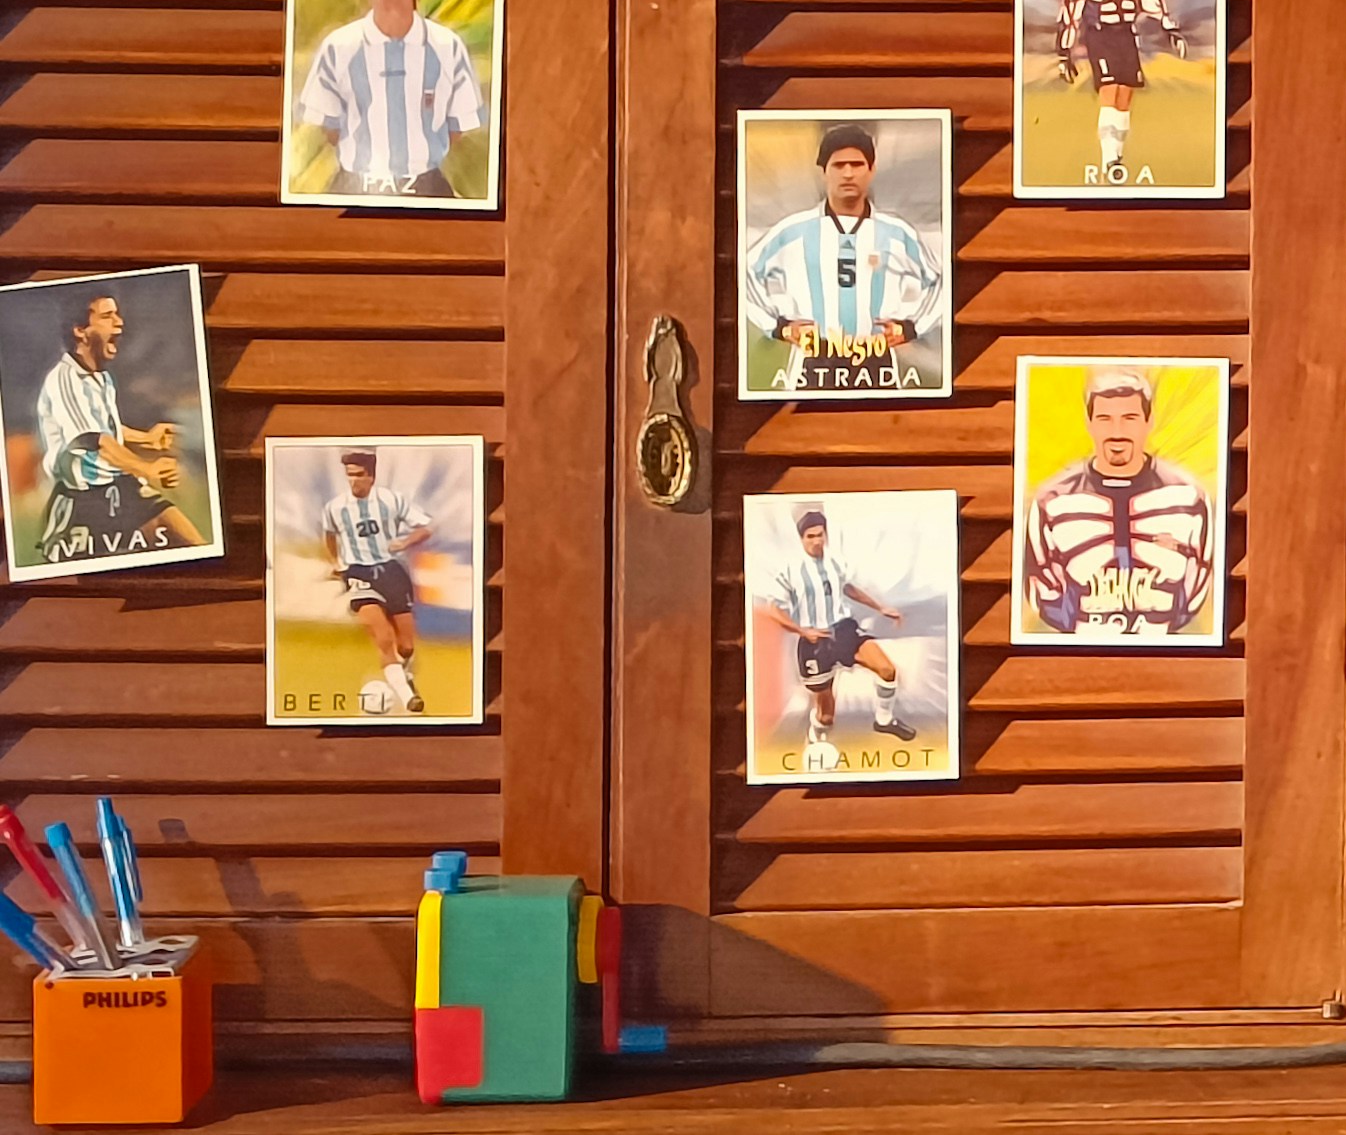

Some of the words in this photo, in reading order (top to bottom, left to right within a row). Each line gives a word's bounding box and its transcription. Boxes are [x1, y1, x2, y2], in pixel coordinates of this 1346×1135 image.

[361, 173, 418, 194] PAZ
[1083, 164, 1156, 185] ROA
[837, 258, 857, 289] 5
[799, 322, 821, 358] El
[826, 323, 888, 367] Negro
[770, 366, 922, 389] ASTRADA
[356, 519, 380, 538] 20
[57, 526, 170, 559] VIVAS
[283, 693, 387, 712] BERTI
[780, 748, 935, 771] CHAMOT
[82, 990, 167, 1009] PHILIPS
